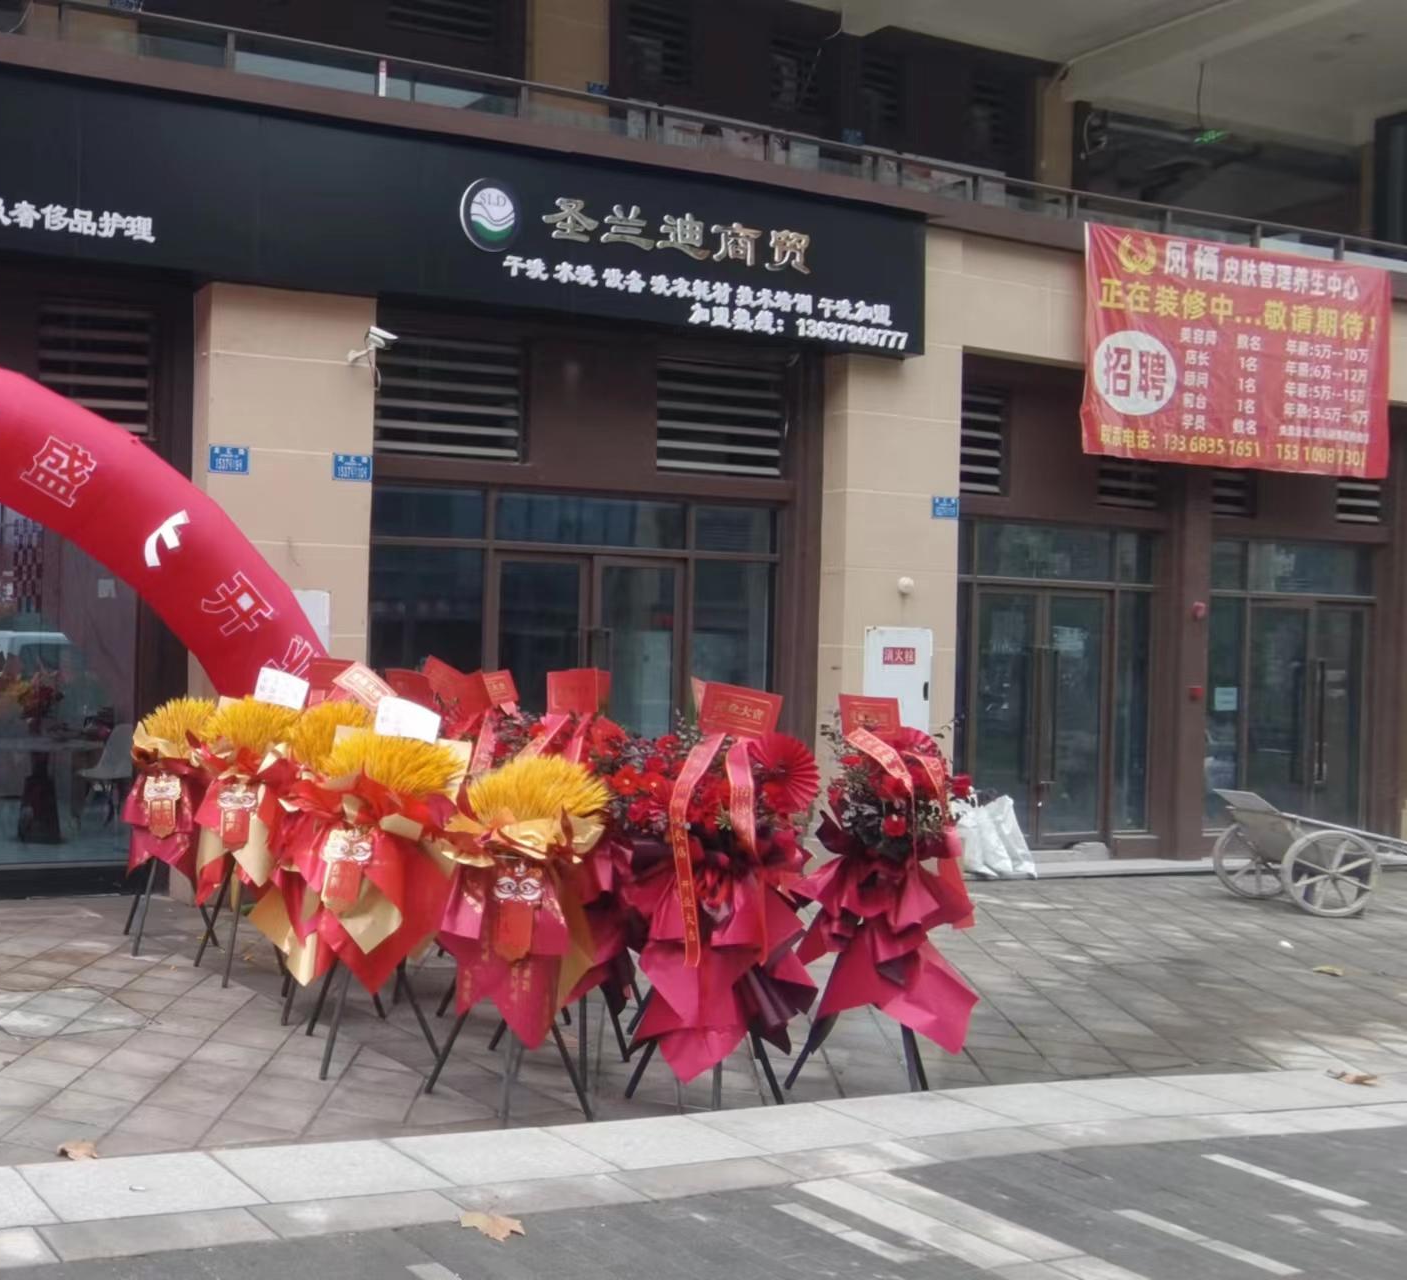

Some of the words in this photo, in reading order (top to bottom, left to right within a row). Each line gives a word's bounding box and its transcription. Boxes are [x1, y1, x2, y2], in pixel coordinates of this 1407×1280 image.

[542, 197, 811, 275] 圣兰迪商贸
[1222, 256, 1360, 301] 皮肤管理养生中心
[1104, 343, 1167, 402] 招聘
[1185, 350, 1210, 366] 店长
[884, 650, 914, 662] 消火栓
